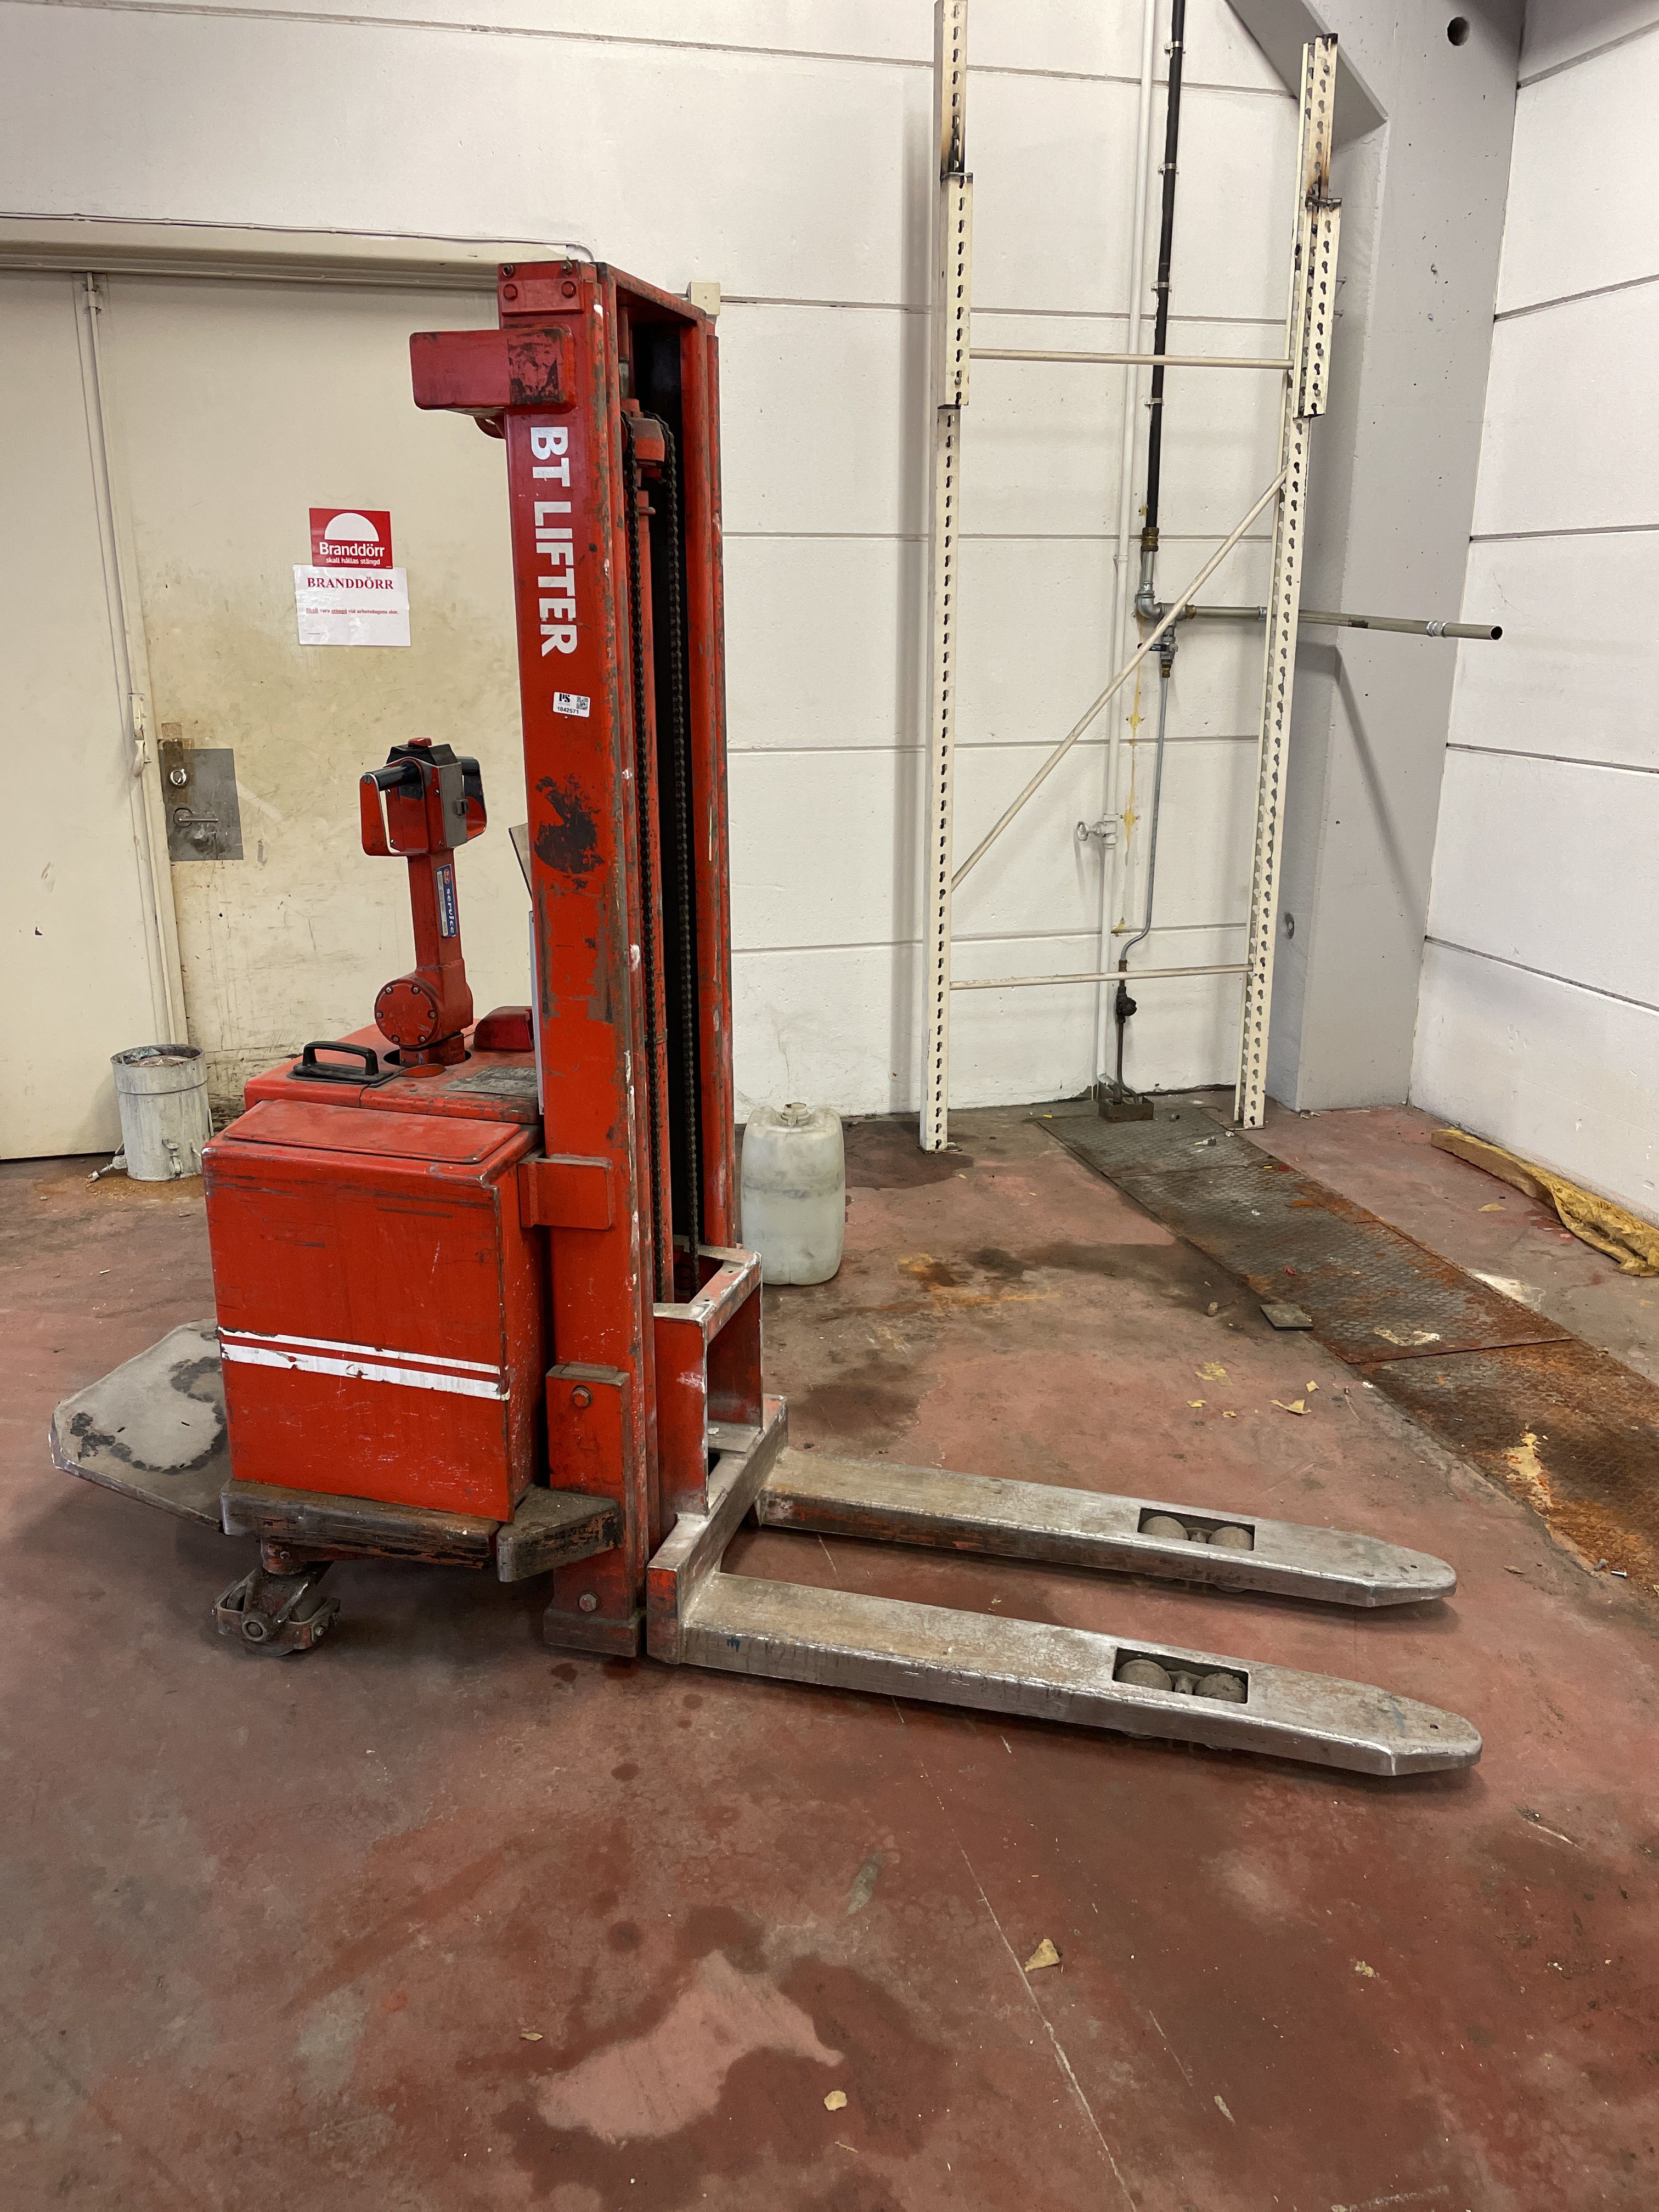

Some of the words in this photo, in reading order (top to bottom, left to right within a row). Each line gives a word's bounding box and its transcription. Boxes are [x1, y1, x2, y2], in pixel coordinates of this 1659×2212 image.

[531, 427, 570, 487] BT
[319, 541, 385, 557] Branddörr
[307, 576, 394, 589] BRANDDÖRR
[534, 501, 578, 657] LIFTER
[557, 706, 579, 714] 1042571
